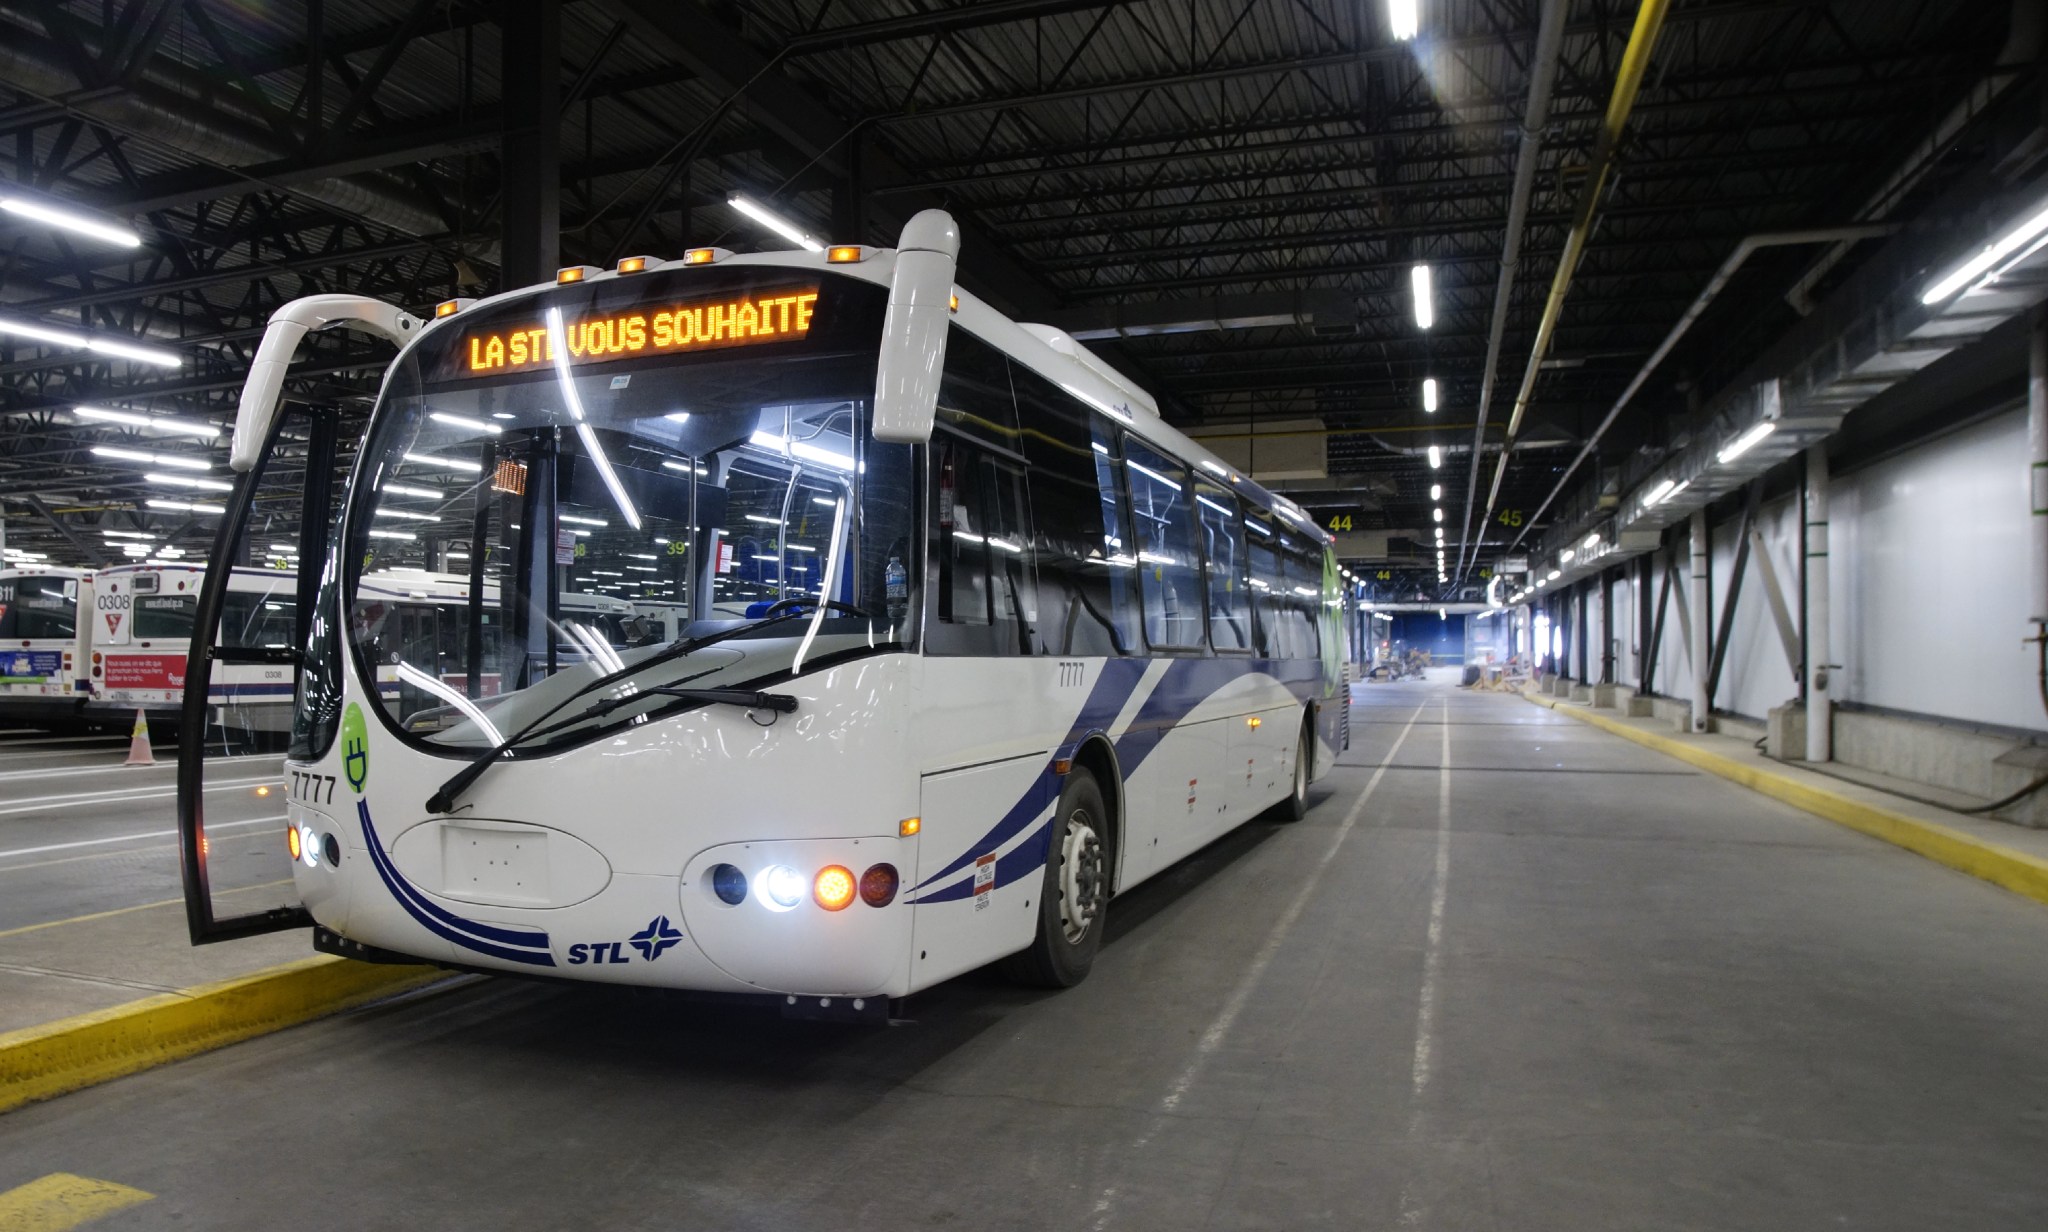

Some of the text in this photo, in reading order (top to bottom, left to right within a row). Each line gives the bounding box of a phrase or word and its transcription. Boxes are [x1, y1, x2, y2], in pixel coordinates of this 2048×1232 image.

[471, 337, 504, 370] LA
[568, 316, 647, 357] VOUS
[653, 293, 818, 347] SOUHAITE
[1329, 515, 1352, 531] 44
[1498, 509, 1522, 527] 45
[666, 541, 686, 555] 39
[275, 559, 288, 570] 35
[1377, 570, 1390, 580] 44
[98, 594, 130, 610] 0308
[264, 671, 282, 679] 0308
[1059, 662, 1084, 687] 7777
[292, 770, 336, 805] 7777
[567, 942, 630, 965] STL
